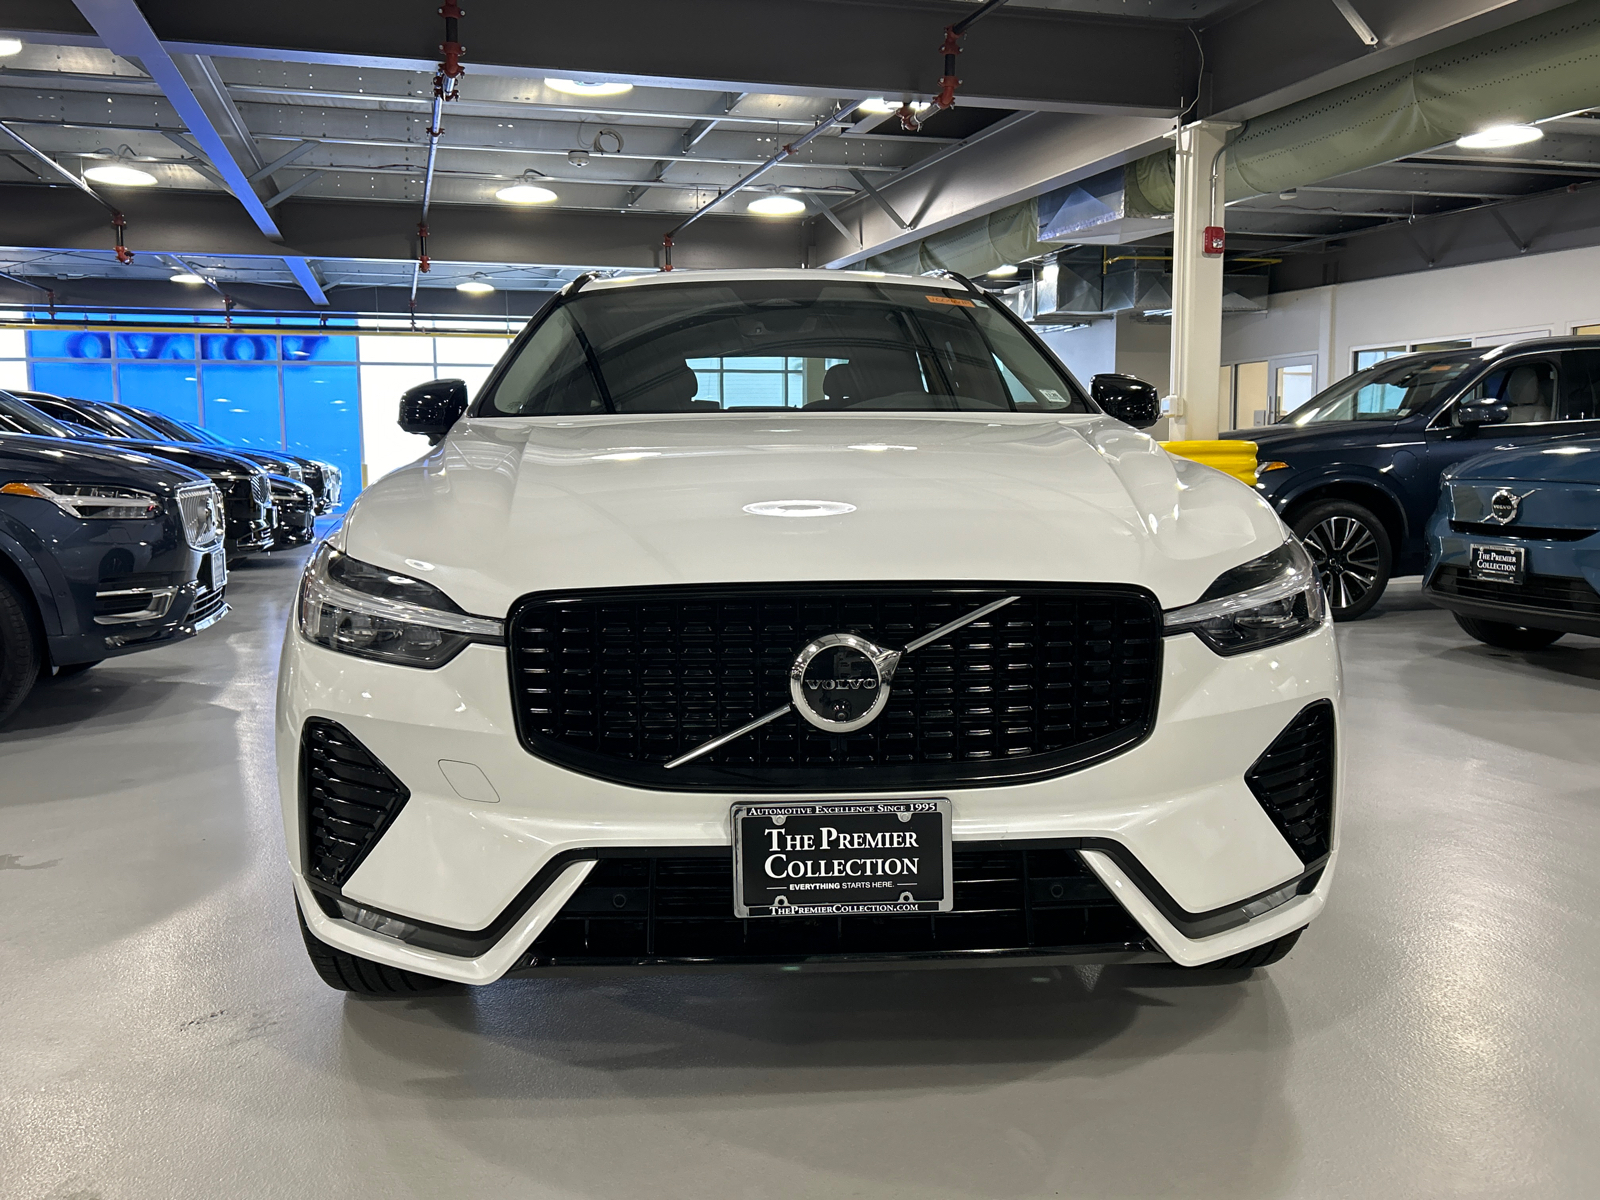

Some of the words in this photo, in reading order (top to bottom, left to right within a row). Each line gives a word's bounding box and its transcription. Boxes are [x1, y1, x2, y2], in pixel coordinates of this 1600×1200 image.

[1478, 551, 1490, 561] THE
[1491, 552, 1516, 563] PREMIER
[1477, 560, 1516, 571] COLLECTION
[805, 678, 877, 690] VOLVO
[748, 807, 812, 816] AUTOMOTIVE
[815, 805, 874, 814] EXCELLENCE
[877, 804, 906, 812] SINCE
[910, 803, 936, 811] 1995
[764, 828, 815, 851] THE
[819, 827, 919, 850] PREMIER
[764, 854, 919, 879] COLLECTION
[789, 882, 840, 890] EVERYTHING
[842, 881, 871, 889] STARTS
